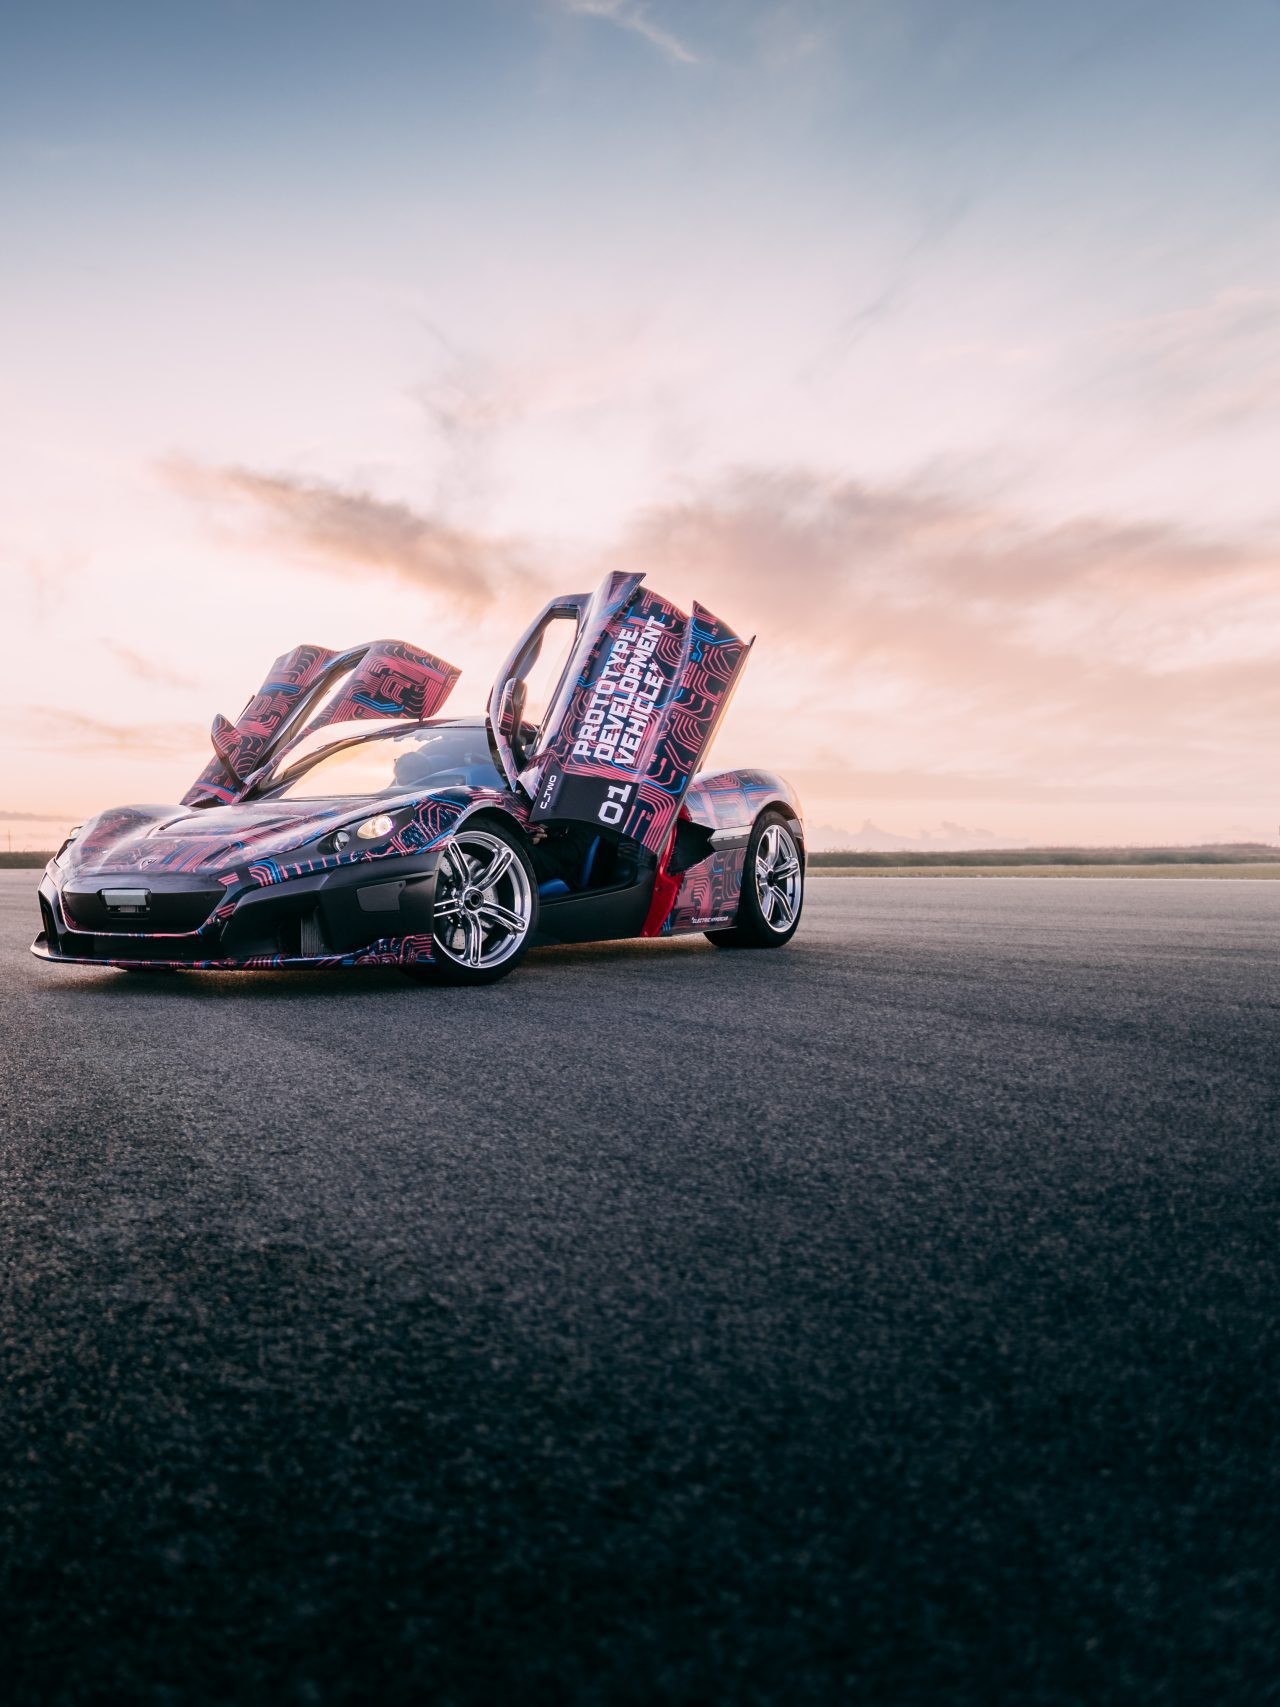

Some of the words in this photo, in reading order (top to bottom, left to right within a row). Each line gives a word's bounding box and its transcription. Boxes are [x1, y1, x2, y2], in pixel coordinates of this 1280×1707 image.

[573, 628, 639, 756] PROTOTYPE
[593, 615, 666, 761] DEVELOPMENT
[540, 775, 557, 809] C_TWO
[598, 784, 633, 825] 01
